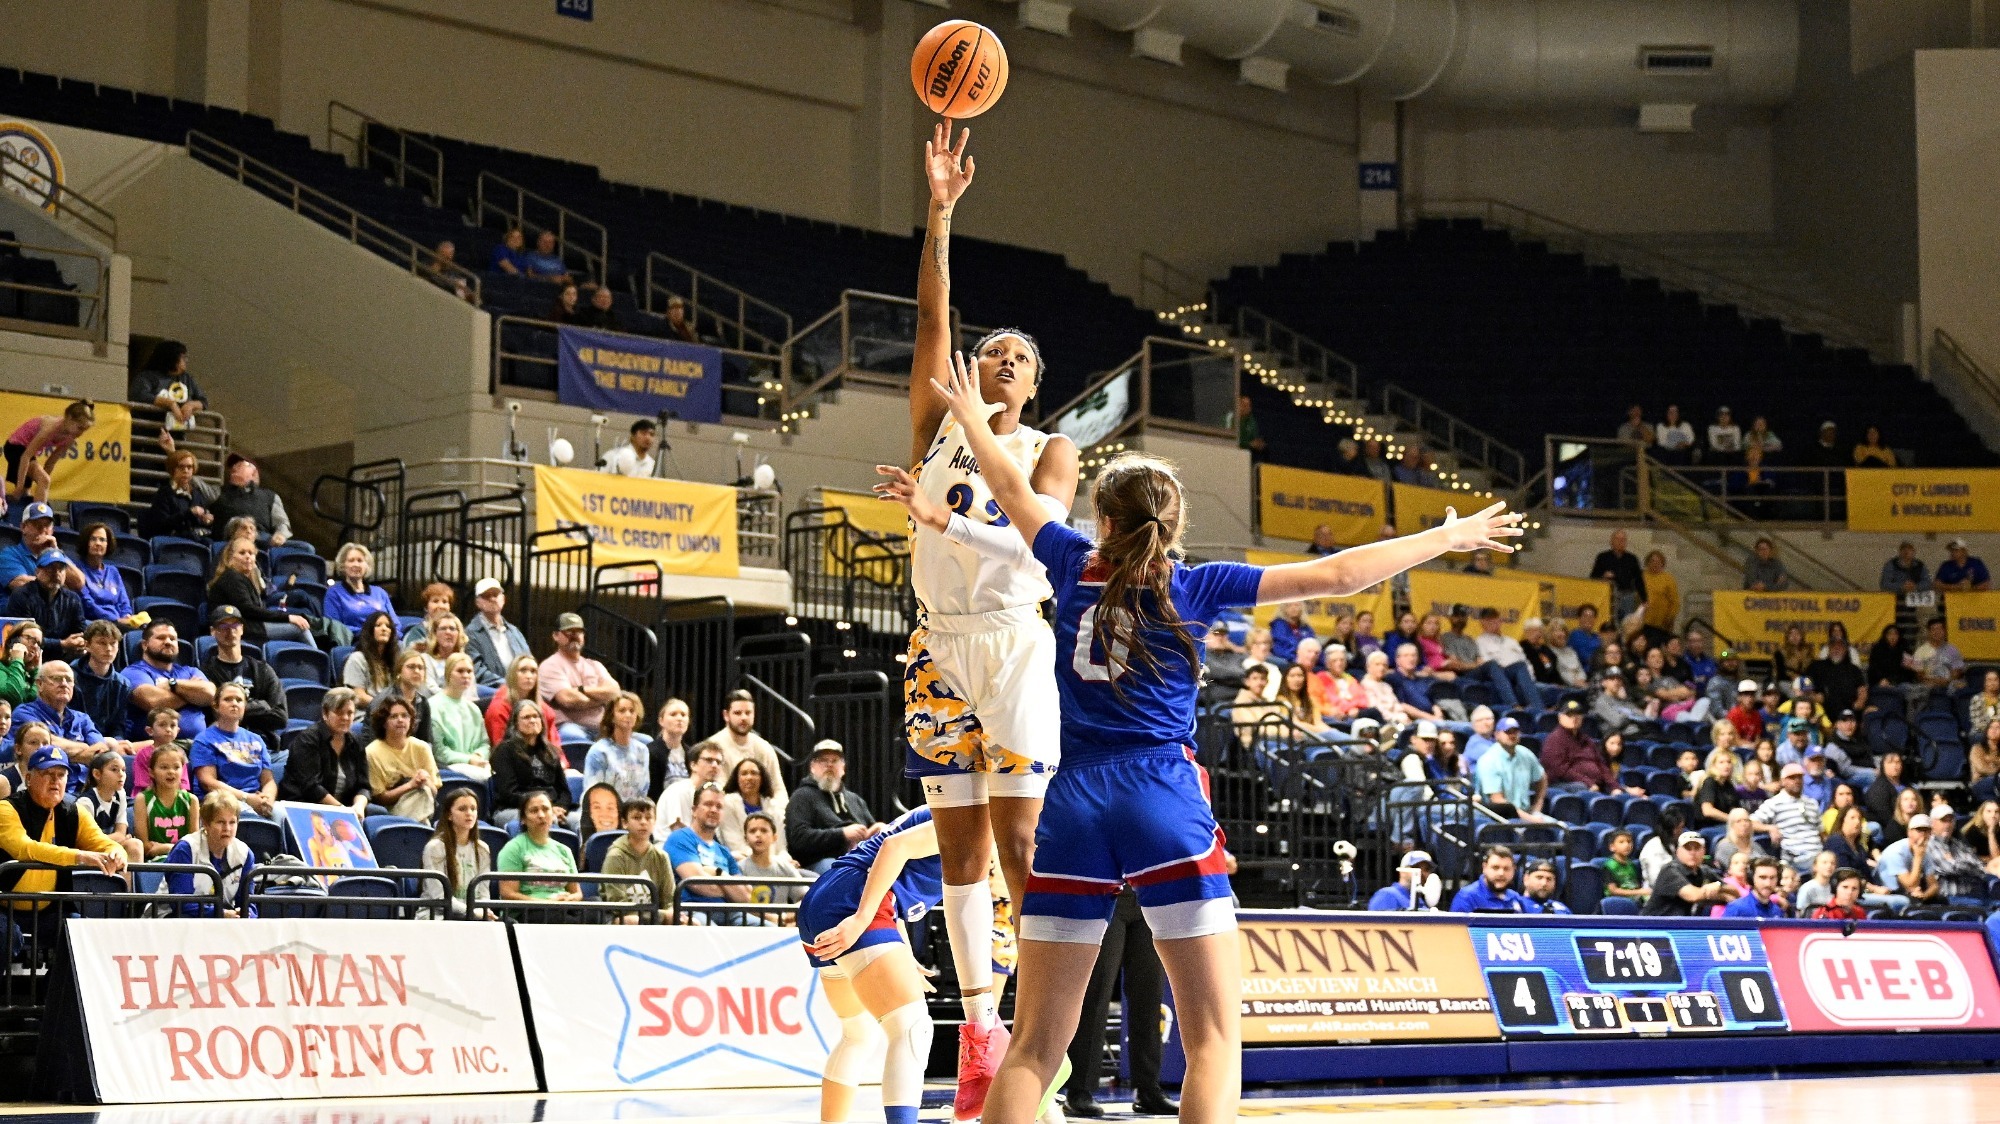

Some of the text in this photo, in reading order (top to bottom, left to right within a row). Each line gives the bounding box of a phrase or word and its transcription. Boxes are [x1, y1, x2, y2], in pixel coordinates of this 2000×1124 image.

[930, 39, 971, 99] Wilson
[100, 441, 126, 462] CO.
[949, 445, 983, 476] Ange
[581, 493, 695, 523] 1ST COMMUNITY
[622, 528, 672, 551] CREDIT
[677, 534, 721, 554] UNION
[1487, 932, 1752, 977] ASU 7:19 LCU
[112, 953, 409, 1010] HARTMAN
[1241, 976, 1439, 995] RIDGEVIEW RANCH
[1513, 977, 1536, 1016] 4
[1740, 977, 1765, 1014] 0
[638, 985, 803, 1037] SONIC
[1254, 999, 1334, 1016] Breeding
[1335, 998, 1368, 1013] and
[1371, 998, 1440, 1014] Hunting
[1440, 997, 1491, 1012] Ranch
[1641, 1002, 1653, 1022] 1
[1267, 1018, 1430, 1035] www.4NRanches.com
[160, 1022, 509, 1081] ROOFING INC.
